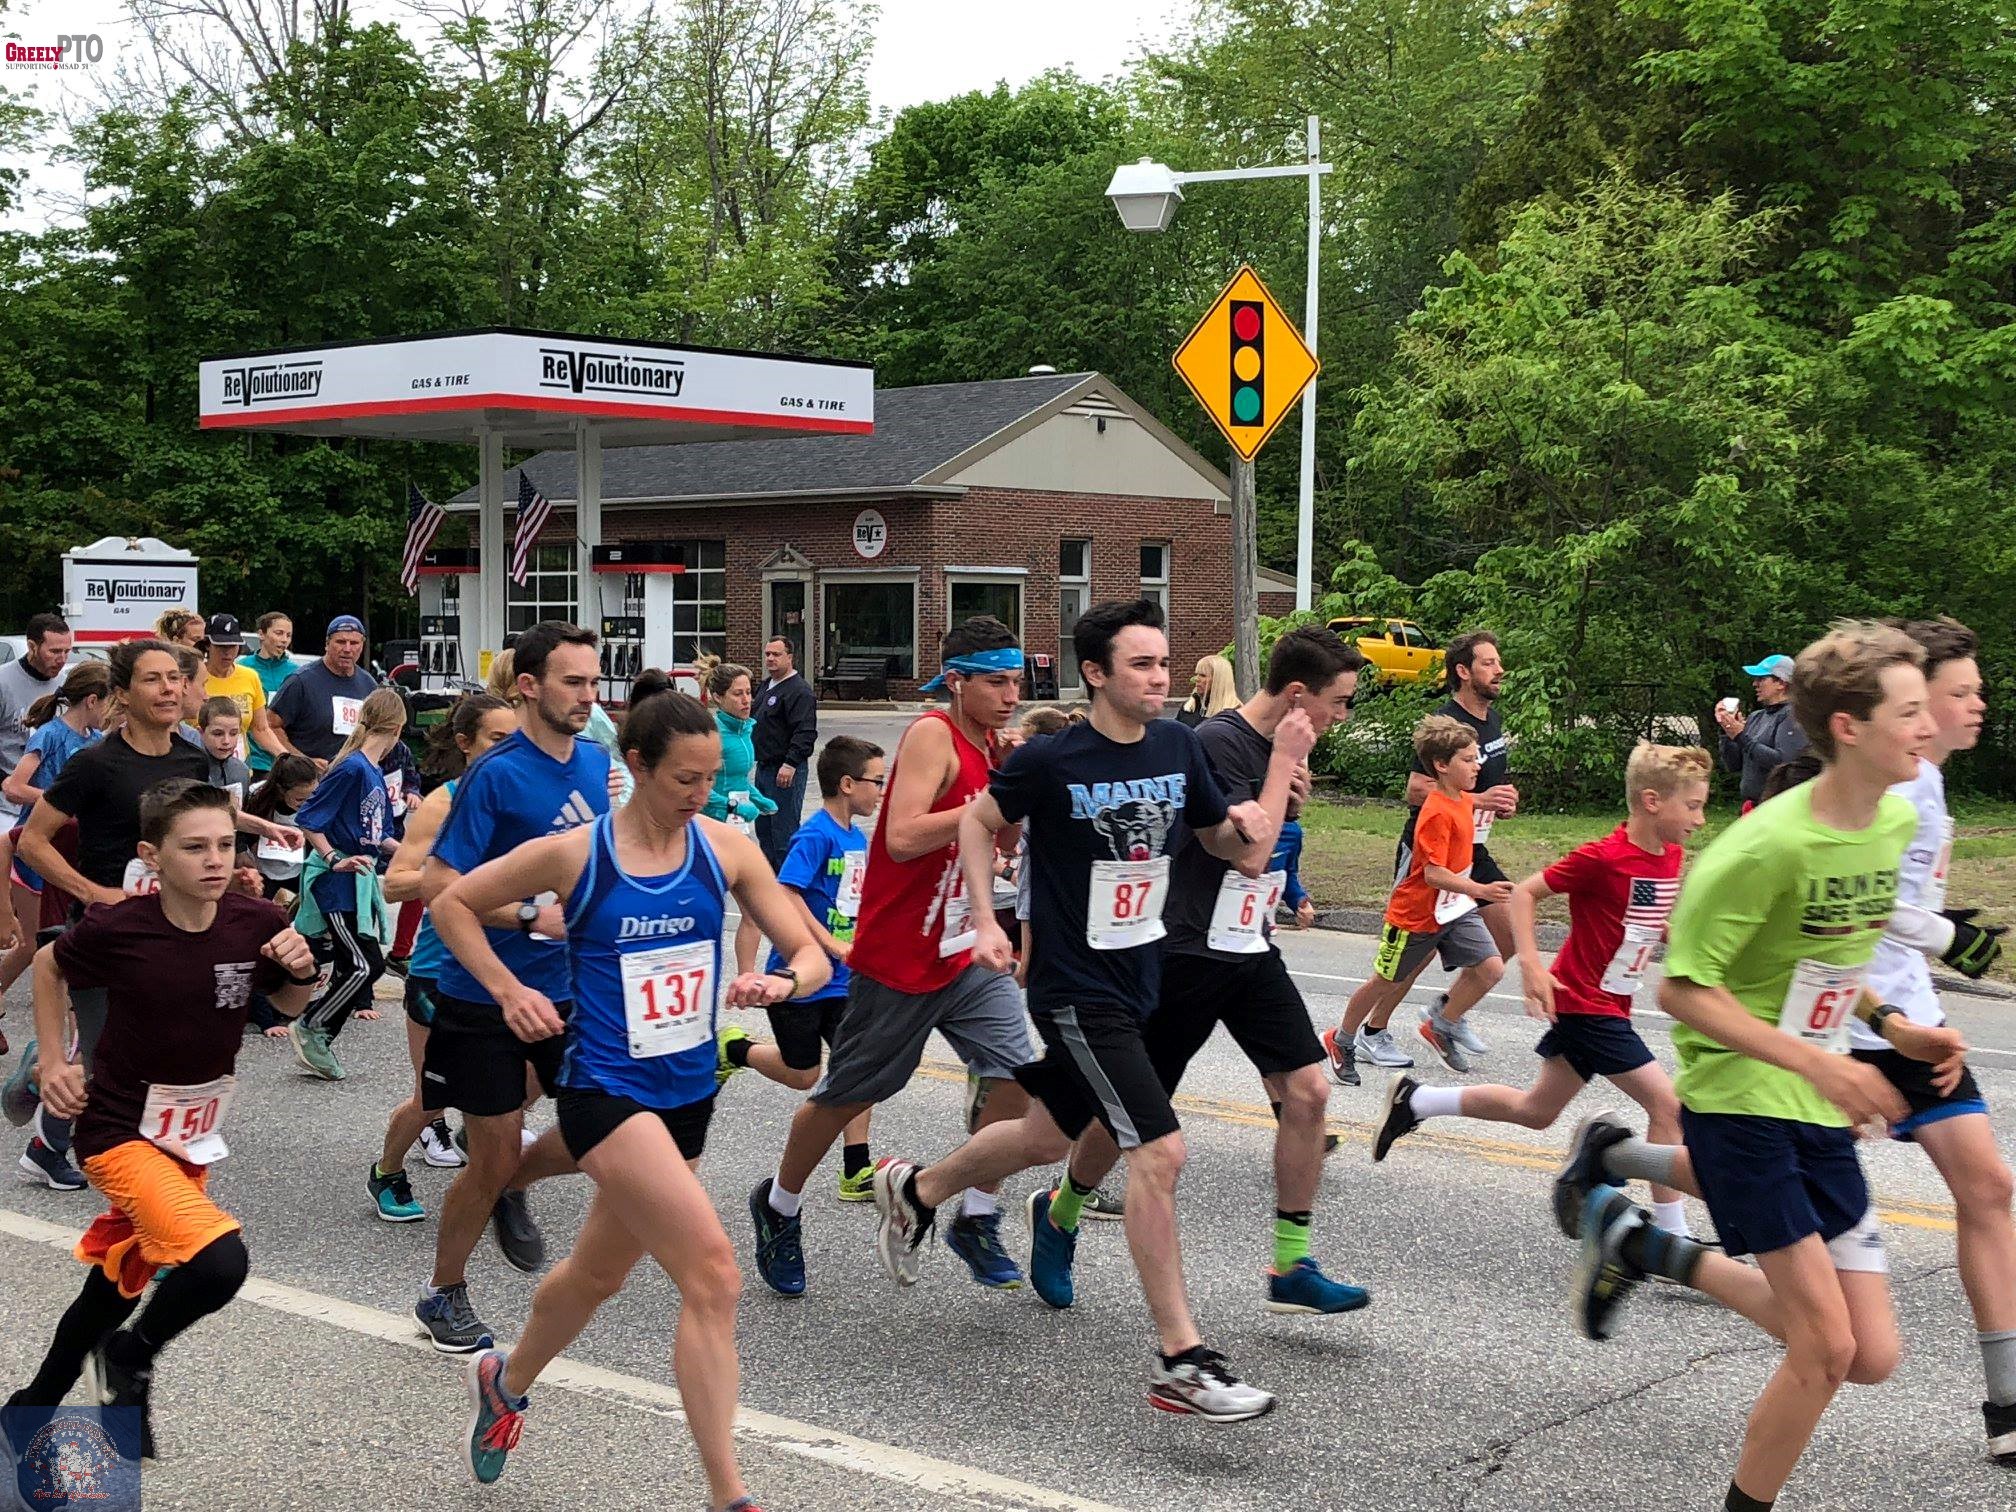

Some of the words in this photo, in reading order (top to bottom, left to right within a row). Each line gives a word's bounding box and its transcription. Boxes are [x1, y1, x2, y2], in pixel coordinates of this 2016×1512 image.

[412, 377, 432, 390] GAS
[434, 377, 442, 388] &
[444, 374, 471, 387] TIRE
[780, 396, 803, 408] GAS
[806, 398, 815, 409] &
[818, 399, 847, 412] TIRE
[1066, 773, 1187, 820] MAINE
[1114, 881, 1154, 919] 87
[1240, 894, 1257, 926] 6
[617, 913, 696, 938] Dirigo
[640, 969, 706, 1021] 137
[154, 1097, 220, 1141] 150
